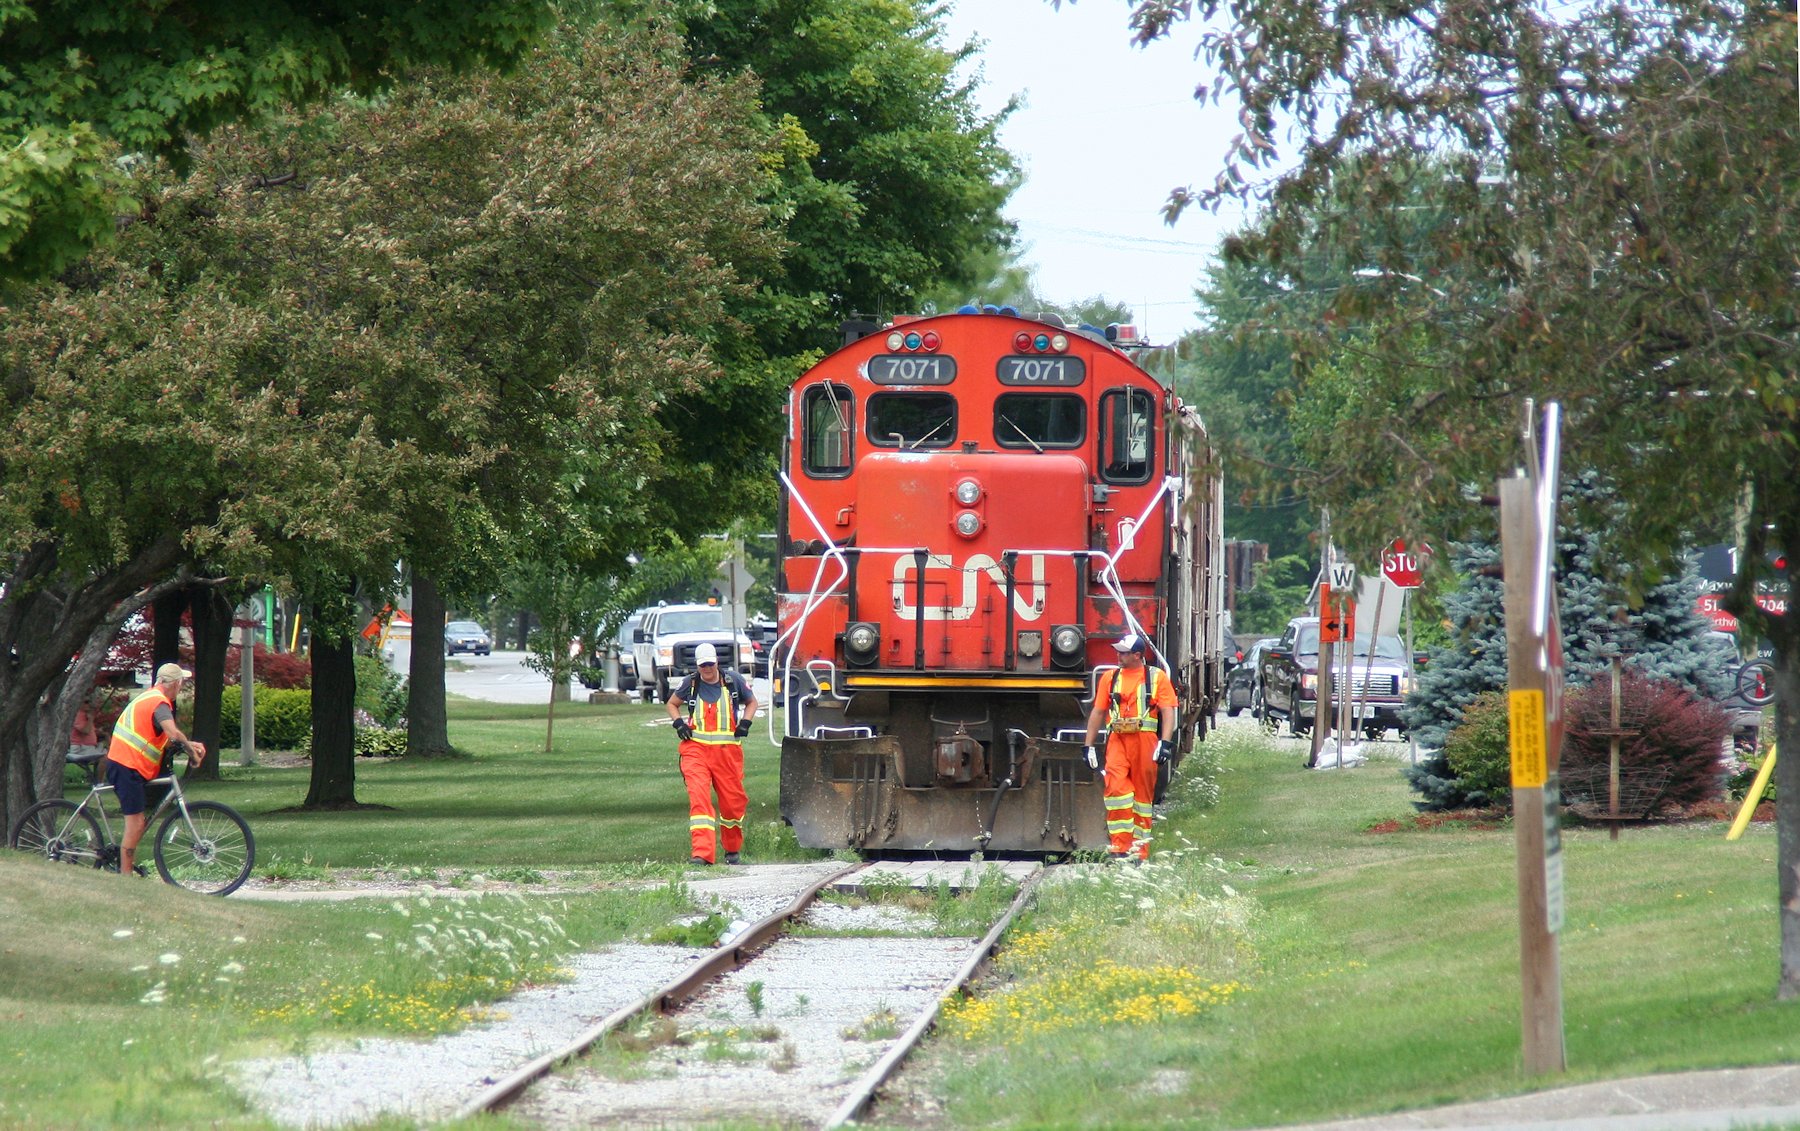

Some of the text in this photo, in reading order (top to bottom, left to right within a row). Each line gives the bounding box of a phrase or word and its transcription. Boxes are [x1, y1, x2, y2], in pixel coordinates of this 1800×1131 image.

[886, 358, 940, 380] 7071
[1010, 360, 1065, 381] 7071
[1384, 552, 1428, 573] STO
[892, 553, 1045, 621] CN
[1333, 569, 1354, 587] W
